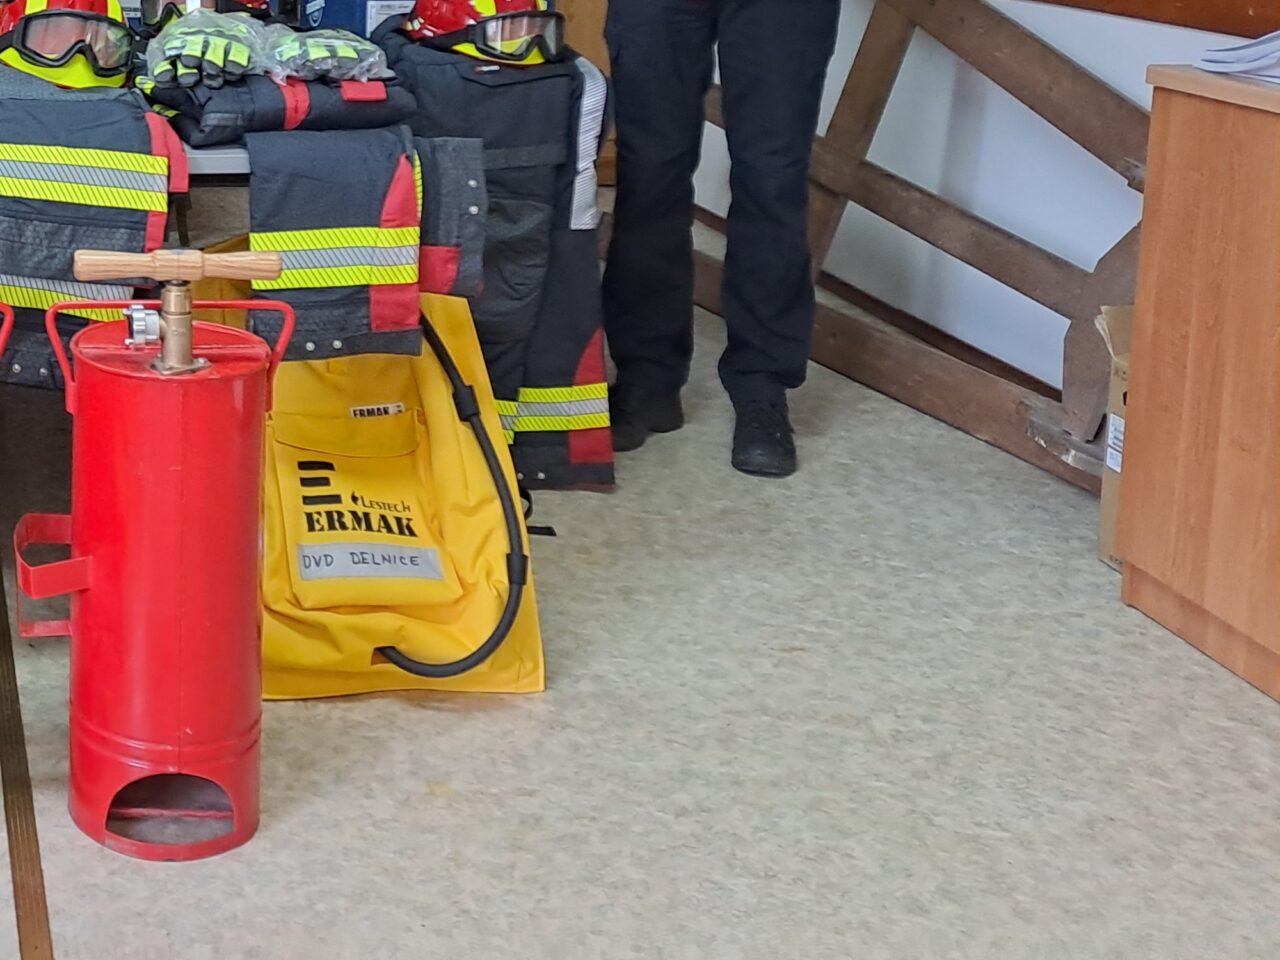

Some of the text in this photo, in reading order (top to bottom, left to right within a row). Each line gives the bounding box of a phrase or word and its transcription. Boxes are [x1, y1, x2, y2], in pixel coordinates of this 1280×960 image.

[304, 510, 419, 538] ERMAK
[302, 551, 420, 570] DVD DELNICE
